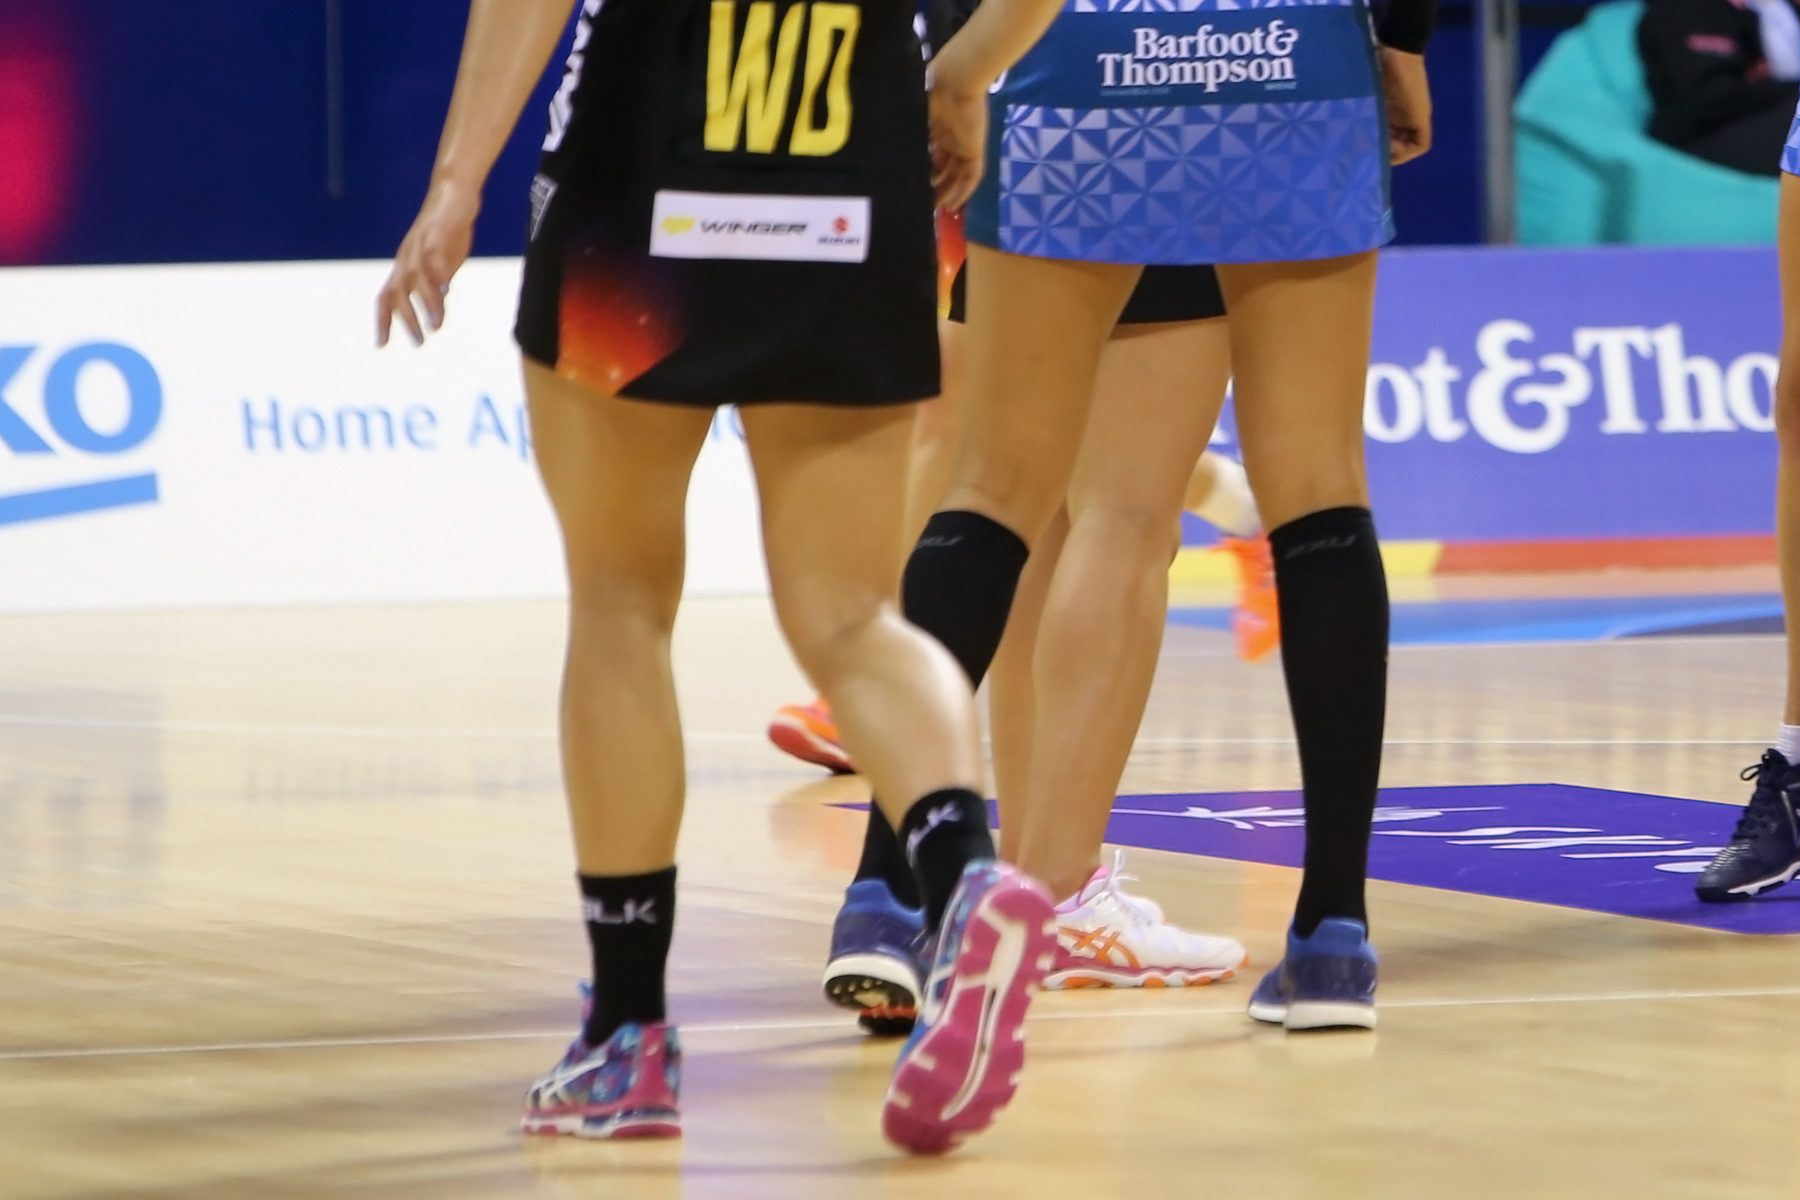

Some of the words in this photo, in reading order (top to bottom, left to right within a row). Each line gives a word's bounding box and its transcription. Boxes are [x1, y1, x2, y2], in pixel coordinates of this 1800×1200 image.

[1133, 19, 1299, 61] Barfoot&
[1097, 52, 1296, 93] Thompson
[240, 397, 437, 454] Home
